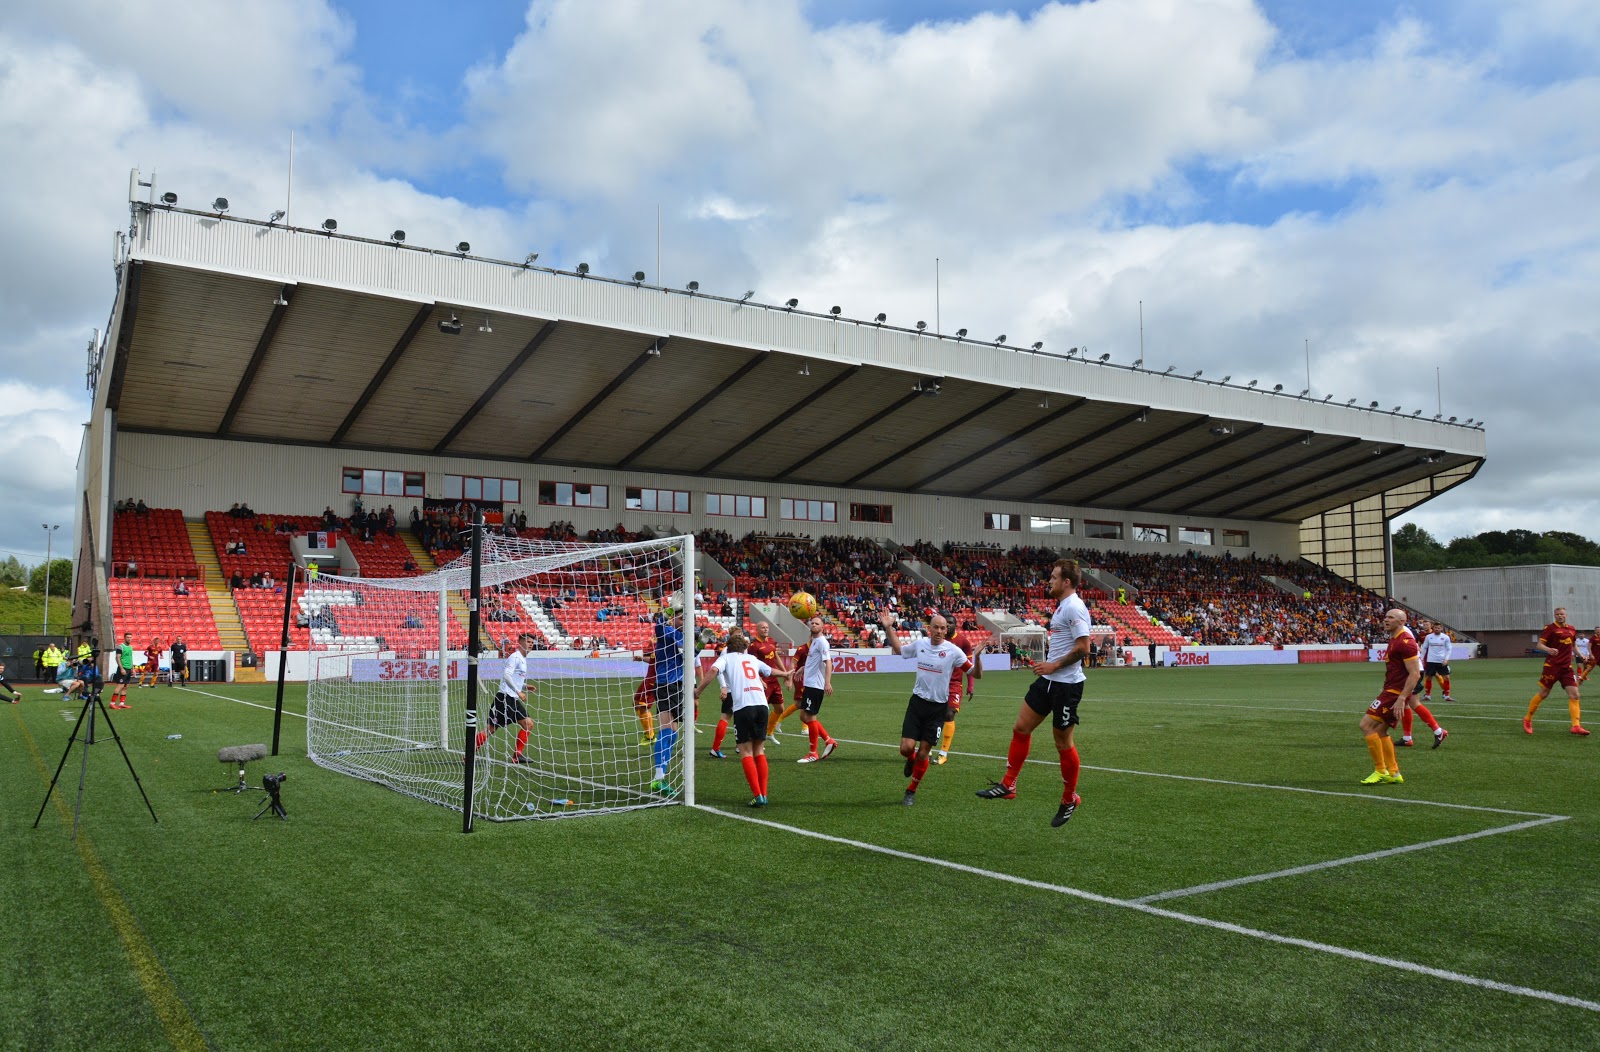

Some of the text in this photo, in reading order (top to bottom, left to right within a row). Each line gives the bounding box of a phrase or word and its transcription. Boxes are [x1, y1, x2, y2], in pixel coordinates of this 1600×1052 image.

[246, 656, 252, 665] 1
[831, 656, 877, 673] 2Red
[1175, 652, 1209, 665] 32Red
[379, 661, 458, 680] 32Red
[741, 660, 757, 680] 6
[806, 697, 812, 708] 4
[955, 694, 960, 703] 5
[1062, 705, 1071, 721] 5
[936, 726, 942, 739] 8
